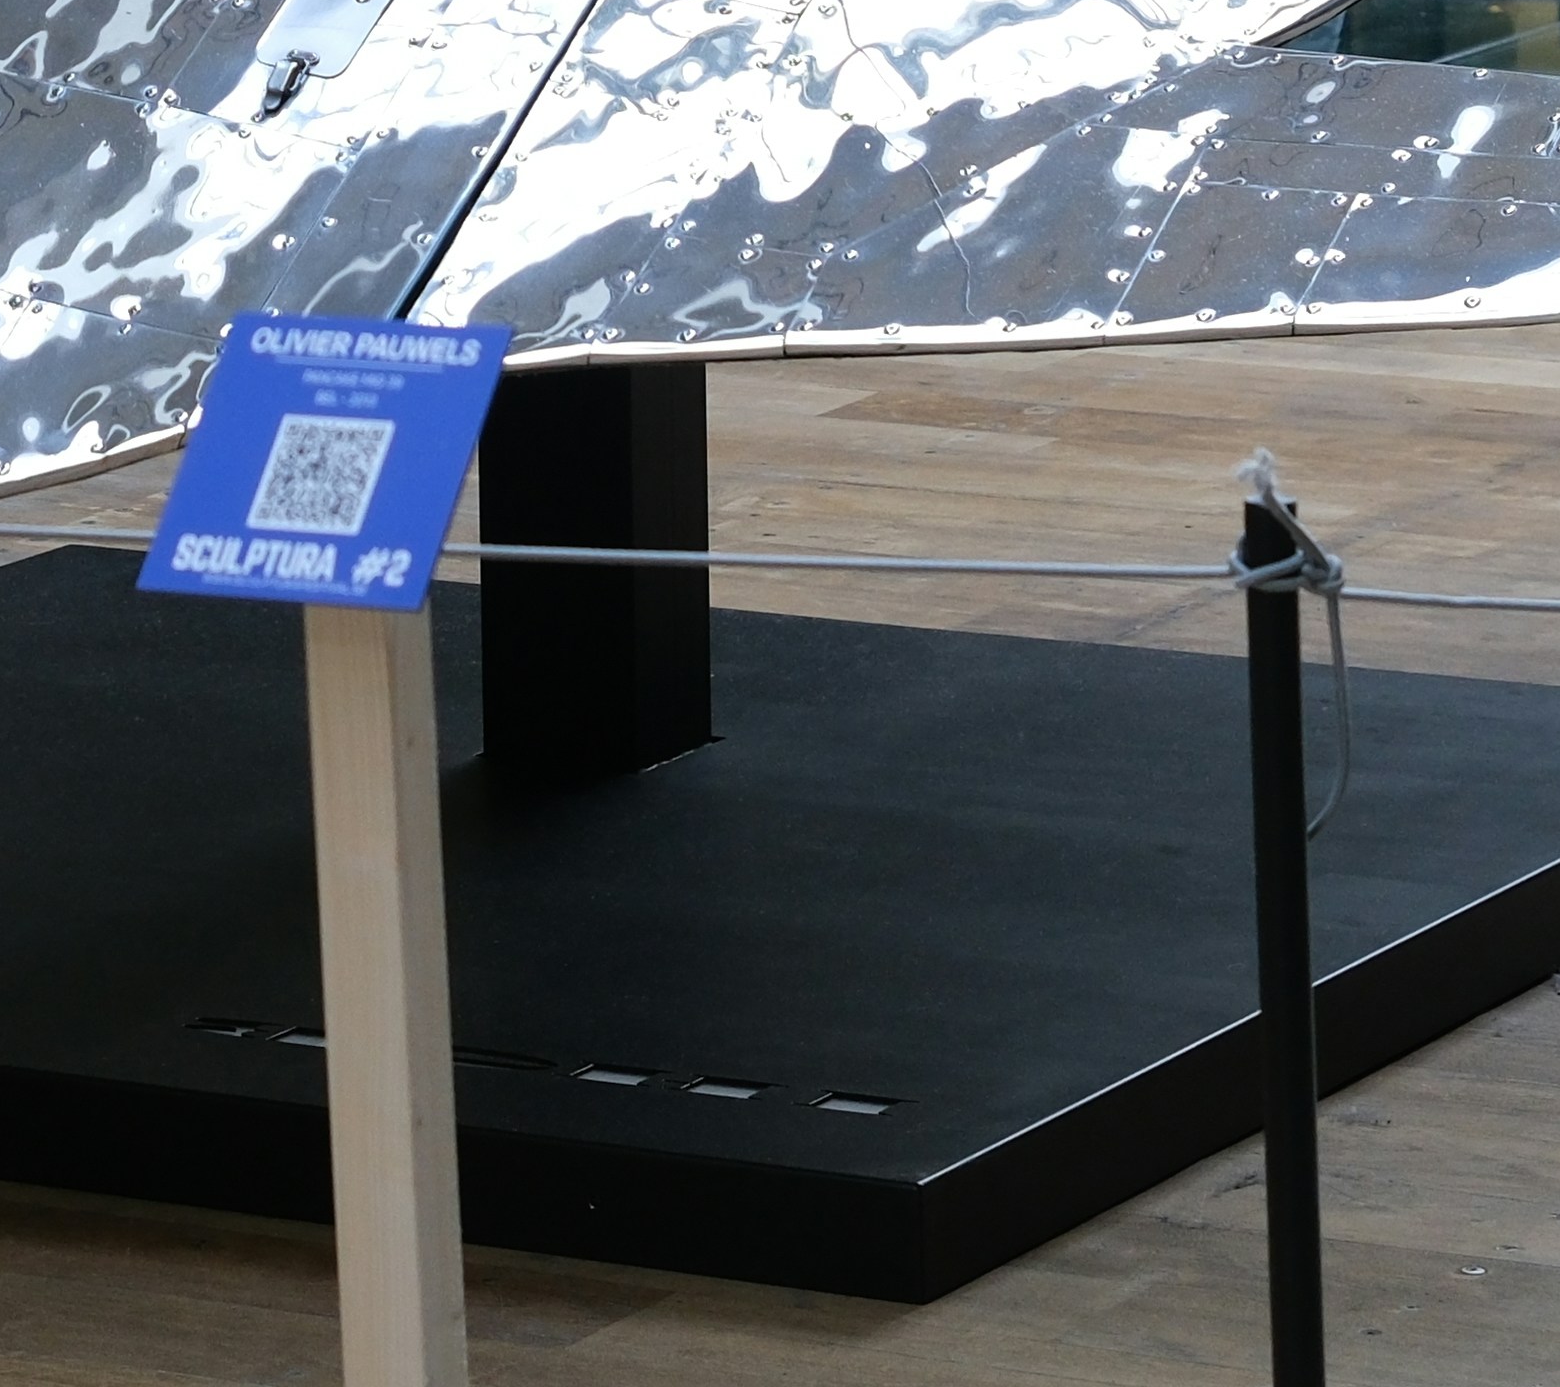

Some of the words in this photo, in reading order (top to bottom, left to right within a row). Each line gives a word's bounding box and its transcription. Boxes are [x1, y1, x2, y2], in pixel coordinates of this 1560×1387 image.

[250, 327, 353, 358] OLIVIER
[353, 331, 482, 367] PAUWELS
[172, 532, 337, 582] SCULPTURA
[351, 547, 412, 587] #2
